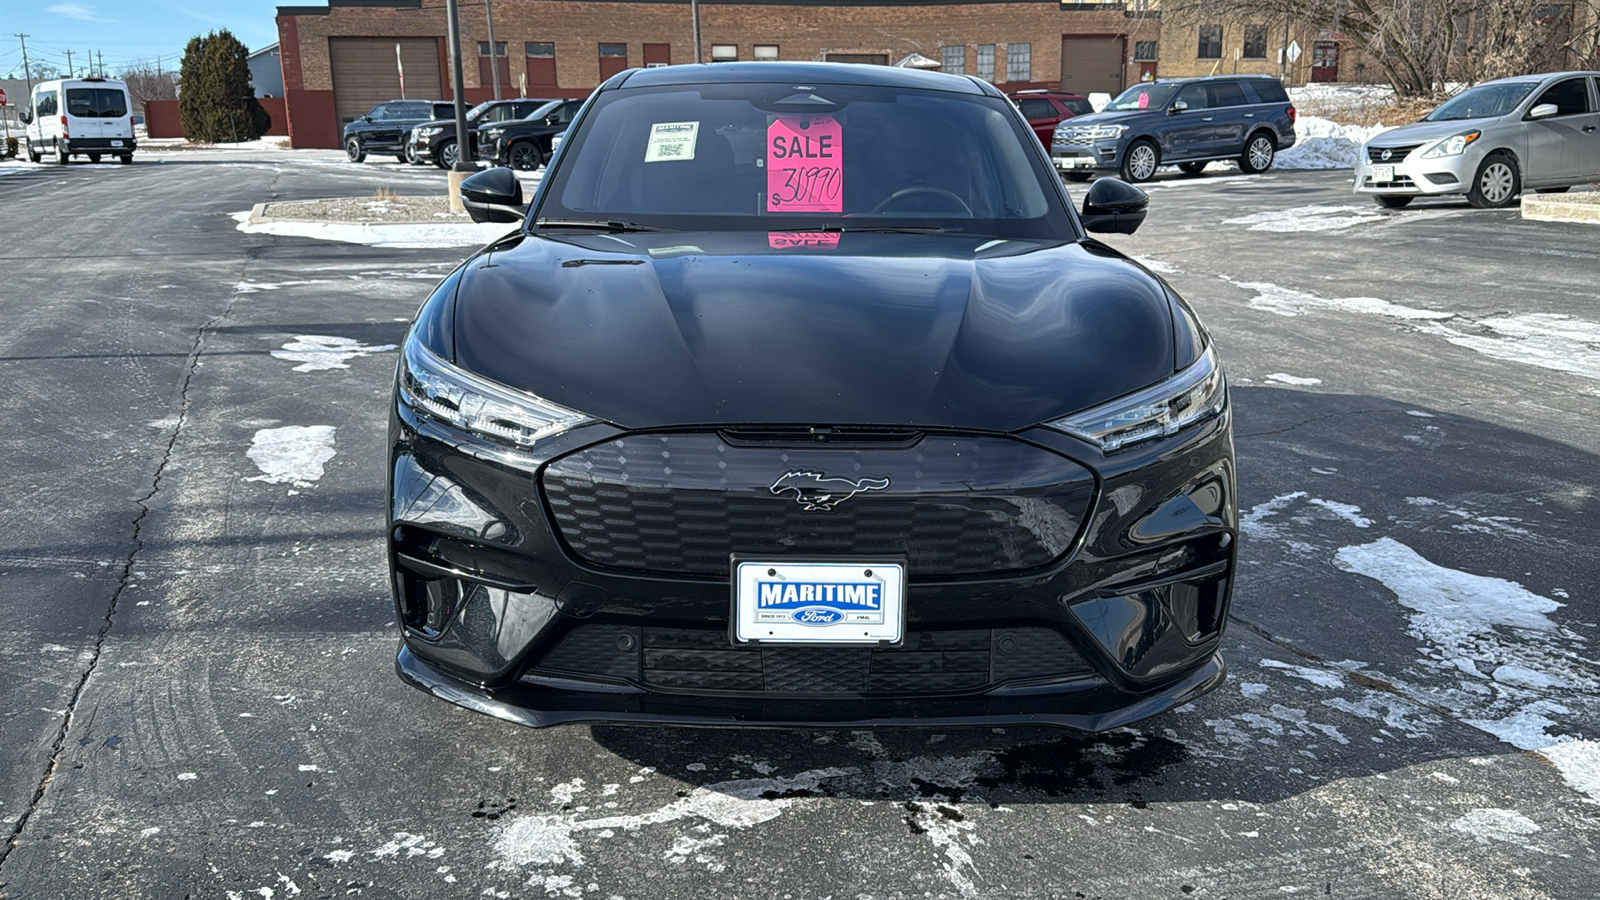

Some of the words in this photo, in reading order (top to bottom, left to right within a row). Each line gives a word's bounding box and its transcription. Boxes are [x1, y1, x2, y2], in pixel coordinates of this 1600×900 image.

[773, 135, 833, 159] SALE
[761, 584, 879, 608] MARITIME
[801, 610, 834, 622] Ford
